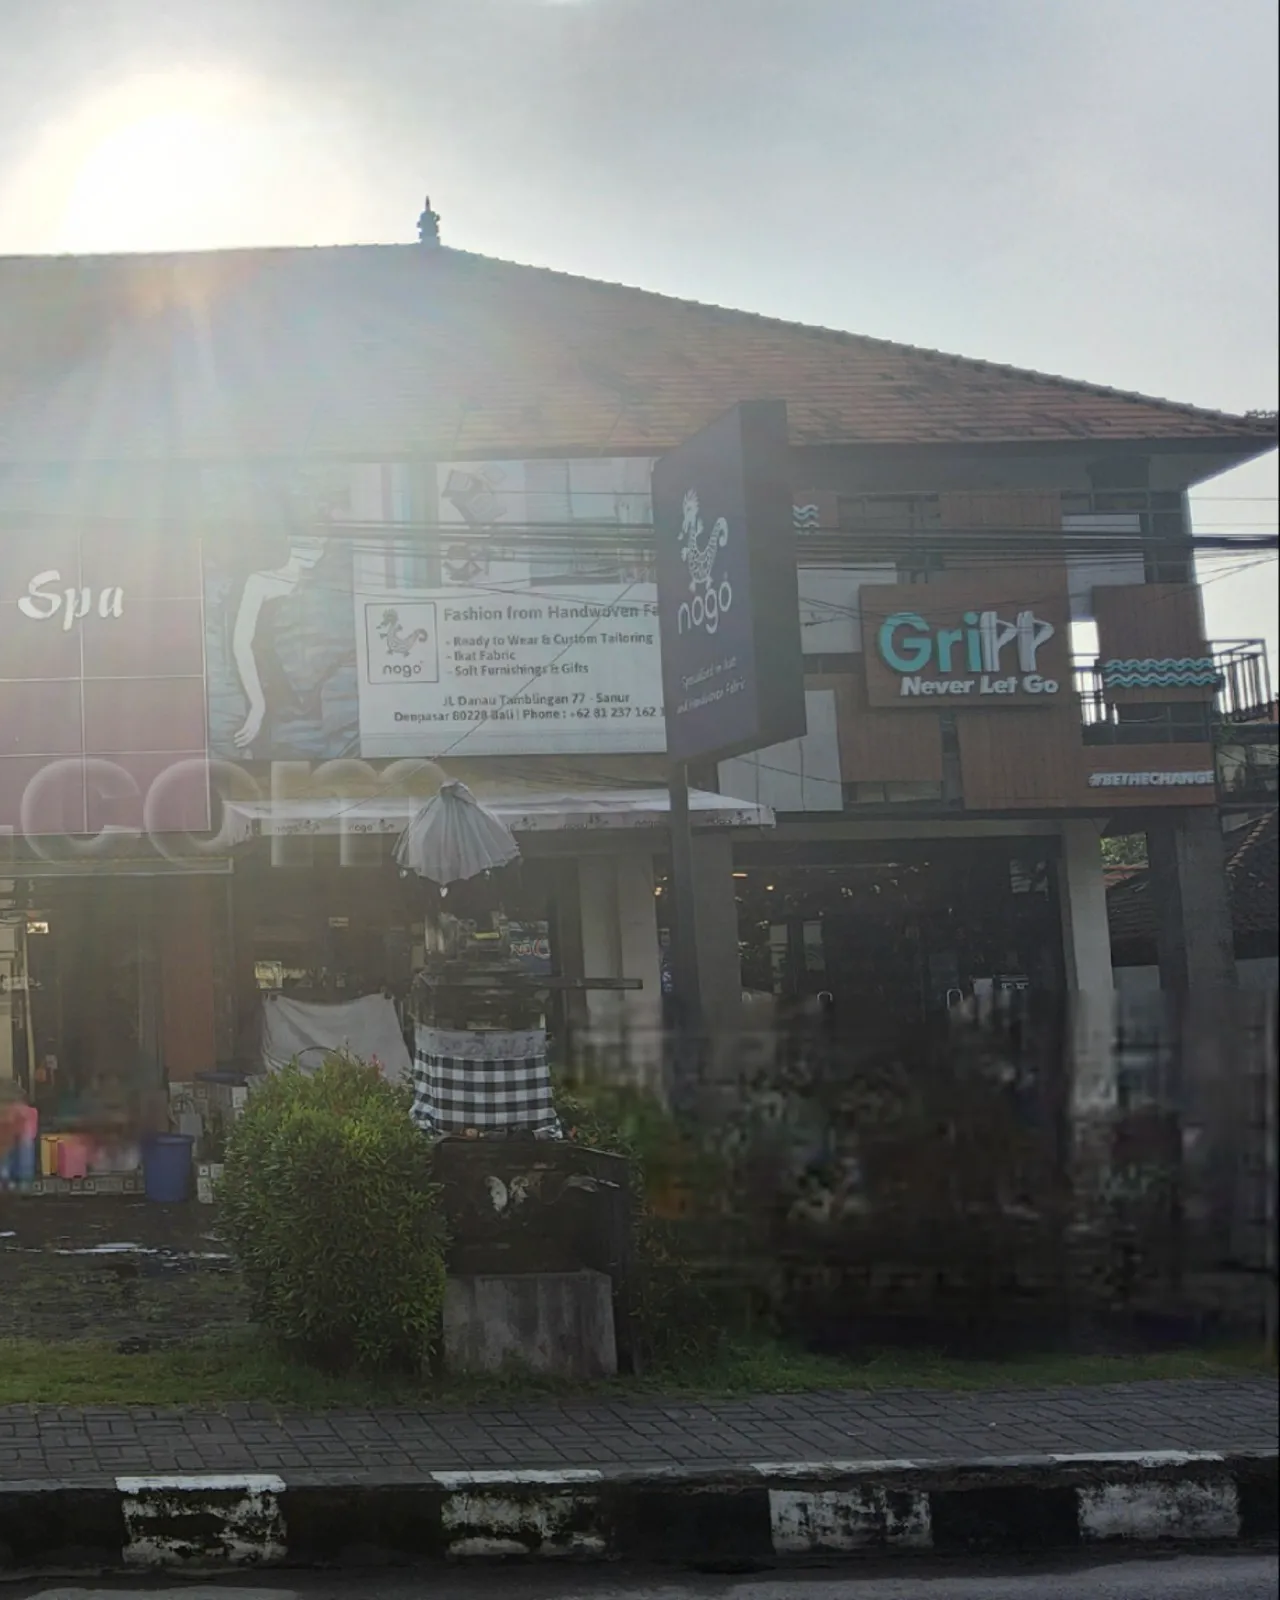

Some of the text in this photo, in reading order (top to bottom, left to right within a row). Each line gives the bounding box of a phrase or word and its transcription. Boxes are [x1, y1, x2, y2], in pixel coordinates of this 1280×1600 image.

[18, 569, 124, 631] Spa
[678, 581, 733, 635] nogo
[444, 605, 502, 621] Fashion
[506, 605, 543, 620] from
[547, 604, 639, 619] Handwoven
[453, 634, 490, 649] Ready
[492, 635, 505, 646] to
[507, 634, 538, 645] Wear
[553, 633, 597, 645] Custom
[600, 631, 654, 645] Tailoring
[454, 650, 476, 661] Ikat
[479, 649, 516, 661] Fabric
[382, 664, 422, 678] nogo
[455, 665, 479, 677] Soft
[481, 663, 547, 678] Furnishings
[561, 662, 589, 673] Gifts
[900, 674, 1059, 696] Never Let Go
[458, 695, 497, 706] Danau
[499, 693, 568, 707] Tamblingan
[572, 693, 586, 704] 77
[596, 692, 630, 703] Sanur
[394, 711, 450, 724] Denpasar
[452, 709, 487, 721] 80228
[490, 709, 514, 720] Bali
[522, 708, 560, 719] Phone
[570, 708, 589, 719] +62
[593, 707, 607, 718] 81
[611, 706, 631, 718] 237
[635, 706, 657, 717] 162
[1088, 770, 1215, 787] #BETHECHANGE
